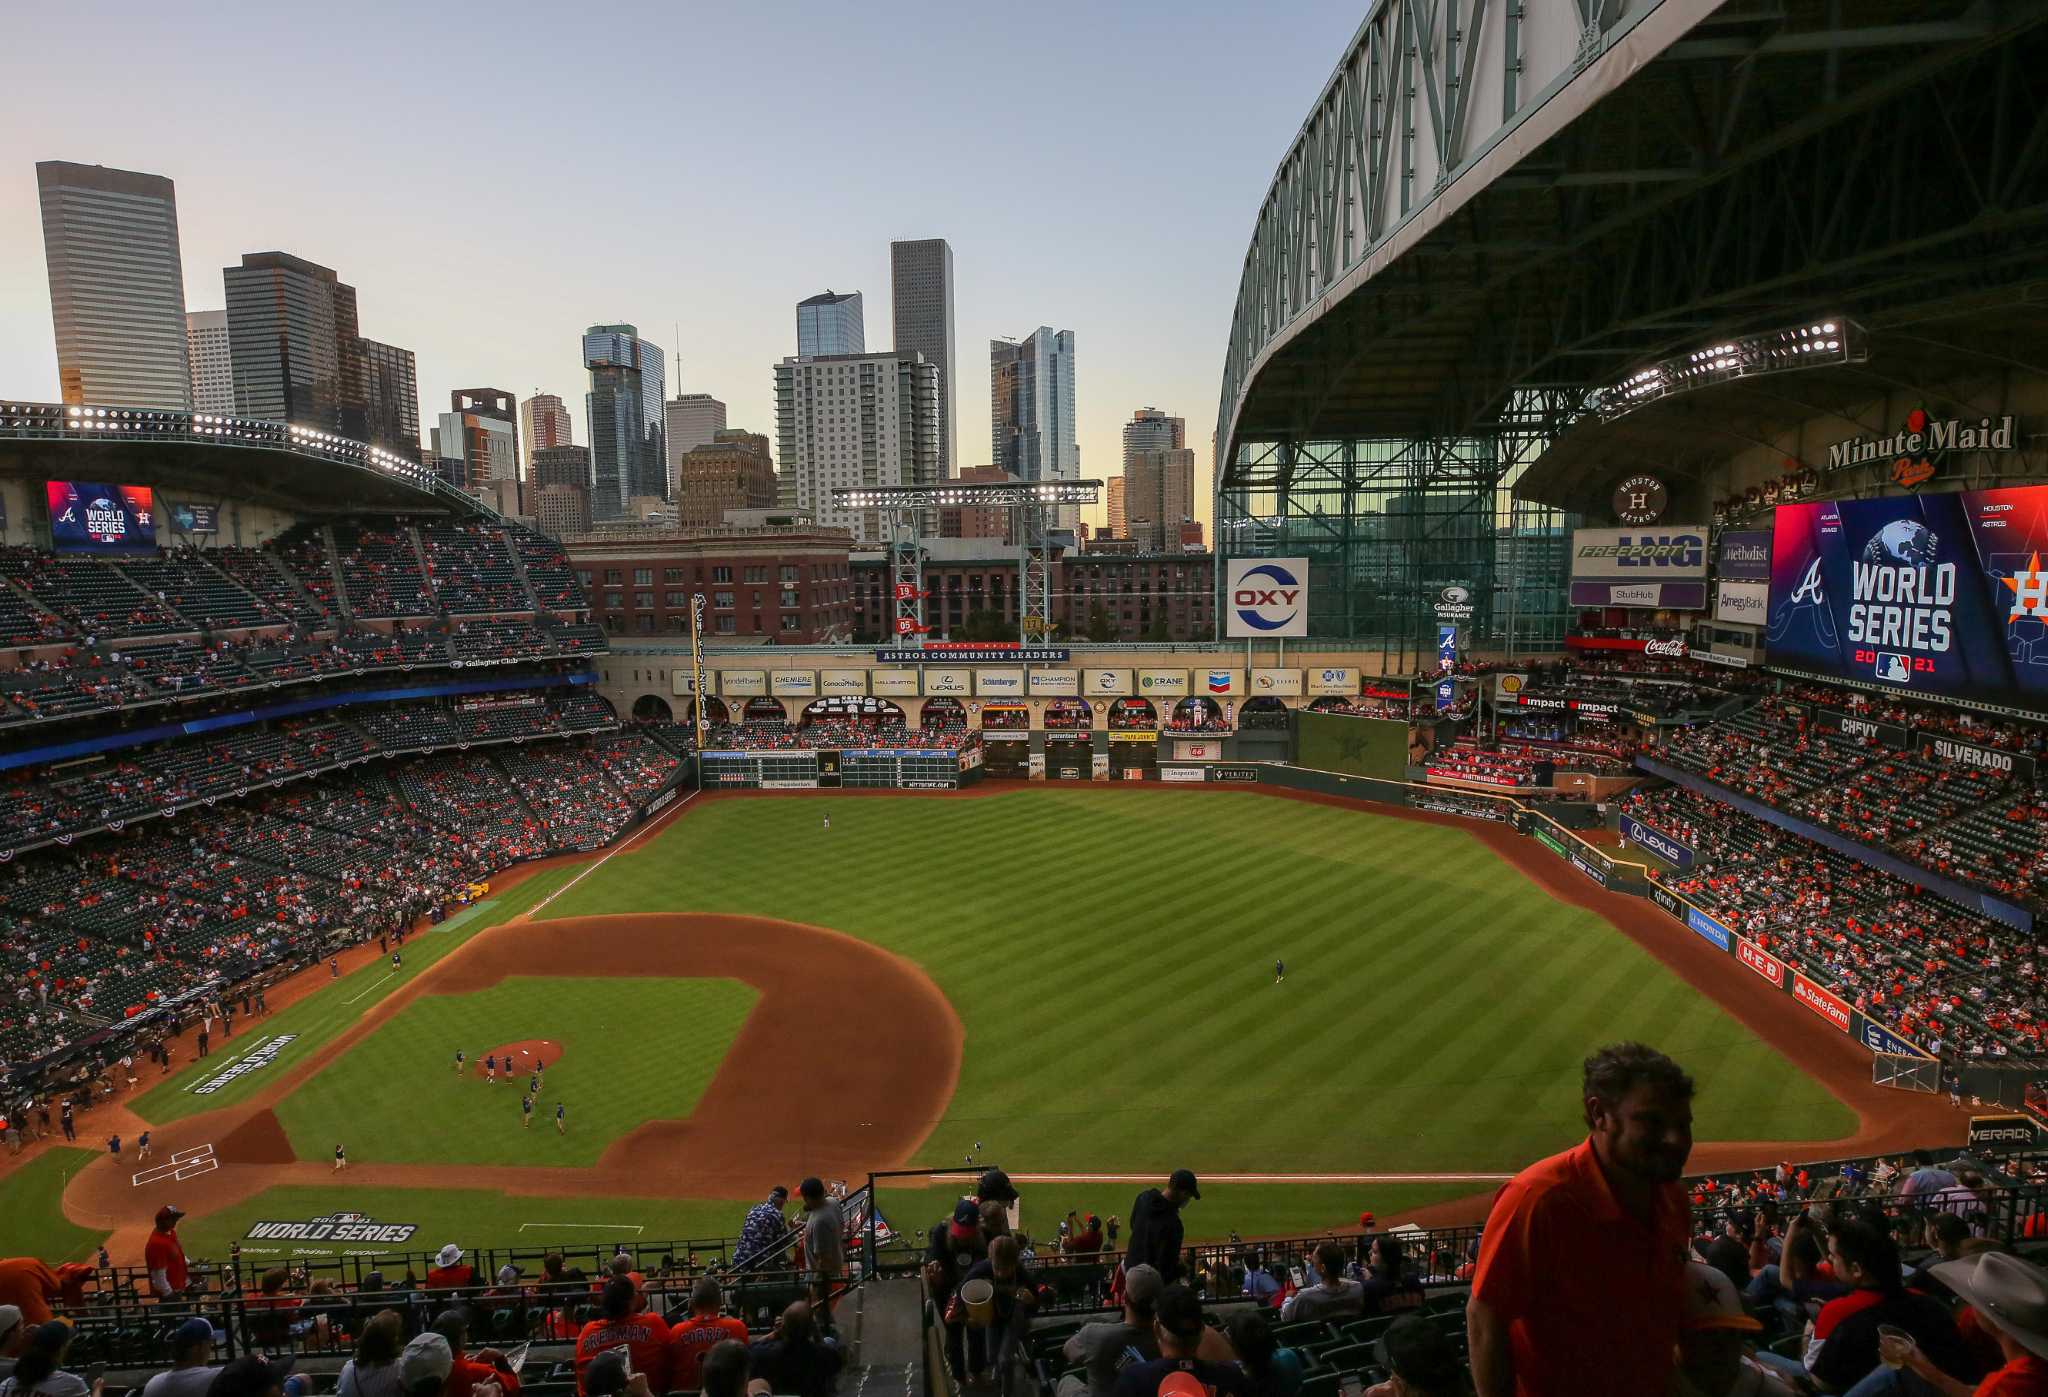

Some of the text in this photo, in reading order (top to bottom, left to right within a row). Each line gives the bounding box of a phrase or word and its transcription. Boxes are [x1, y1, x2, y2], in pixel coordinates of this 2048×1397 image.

[1828, 416, 2012, 470] Minute Maid
[1620, 477, 1661, 492] HOUSTON
[1629, 492, 1648, 509] H
[86, 508, 124, 521] WORLD
[1620, 511, 1657, 523] ASTROS
[88, 521, 126, 533] SERIES
[1982, 520, 2007, 528] ASTROS
[1578, 535, 1703, 567] FREEPORT LNG
[1725, 545, 1767, 560] Methodist
[1853, 560, 1956, 605] WORLD
[900, 587, 910, 595] 19
[1234, 590, 1300, 606] OXY
[1616, 591, 1654, 600] StubHub
[1434, 603, 1474, 613] Gallagher
[1848, 604, 1951, 652] SERIES
[1010, 651, 1063, 659] LEADERS
[1855, 650, 1936, 673] 20 21
[466, 659, 500, 667] Gallagher
[1527, 698, 1566, 709] impact
[1578, 702, 1618, 714] impact
[1841, 718, 1878, 737] CHEVY
[1934, 740, 2012, 771] SILVERADO
[1642, 830, 1679, 860] LEXUS
[1654, 887, 1677, 912] xfinity
[1697, 917, 1728, 944] HONDA
[248, 1222, 416, 1242] WORLD SERIES
